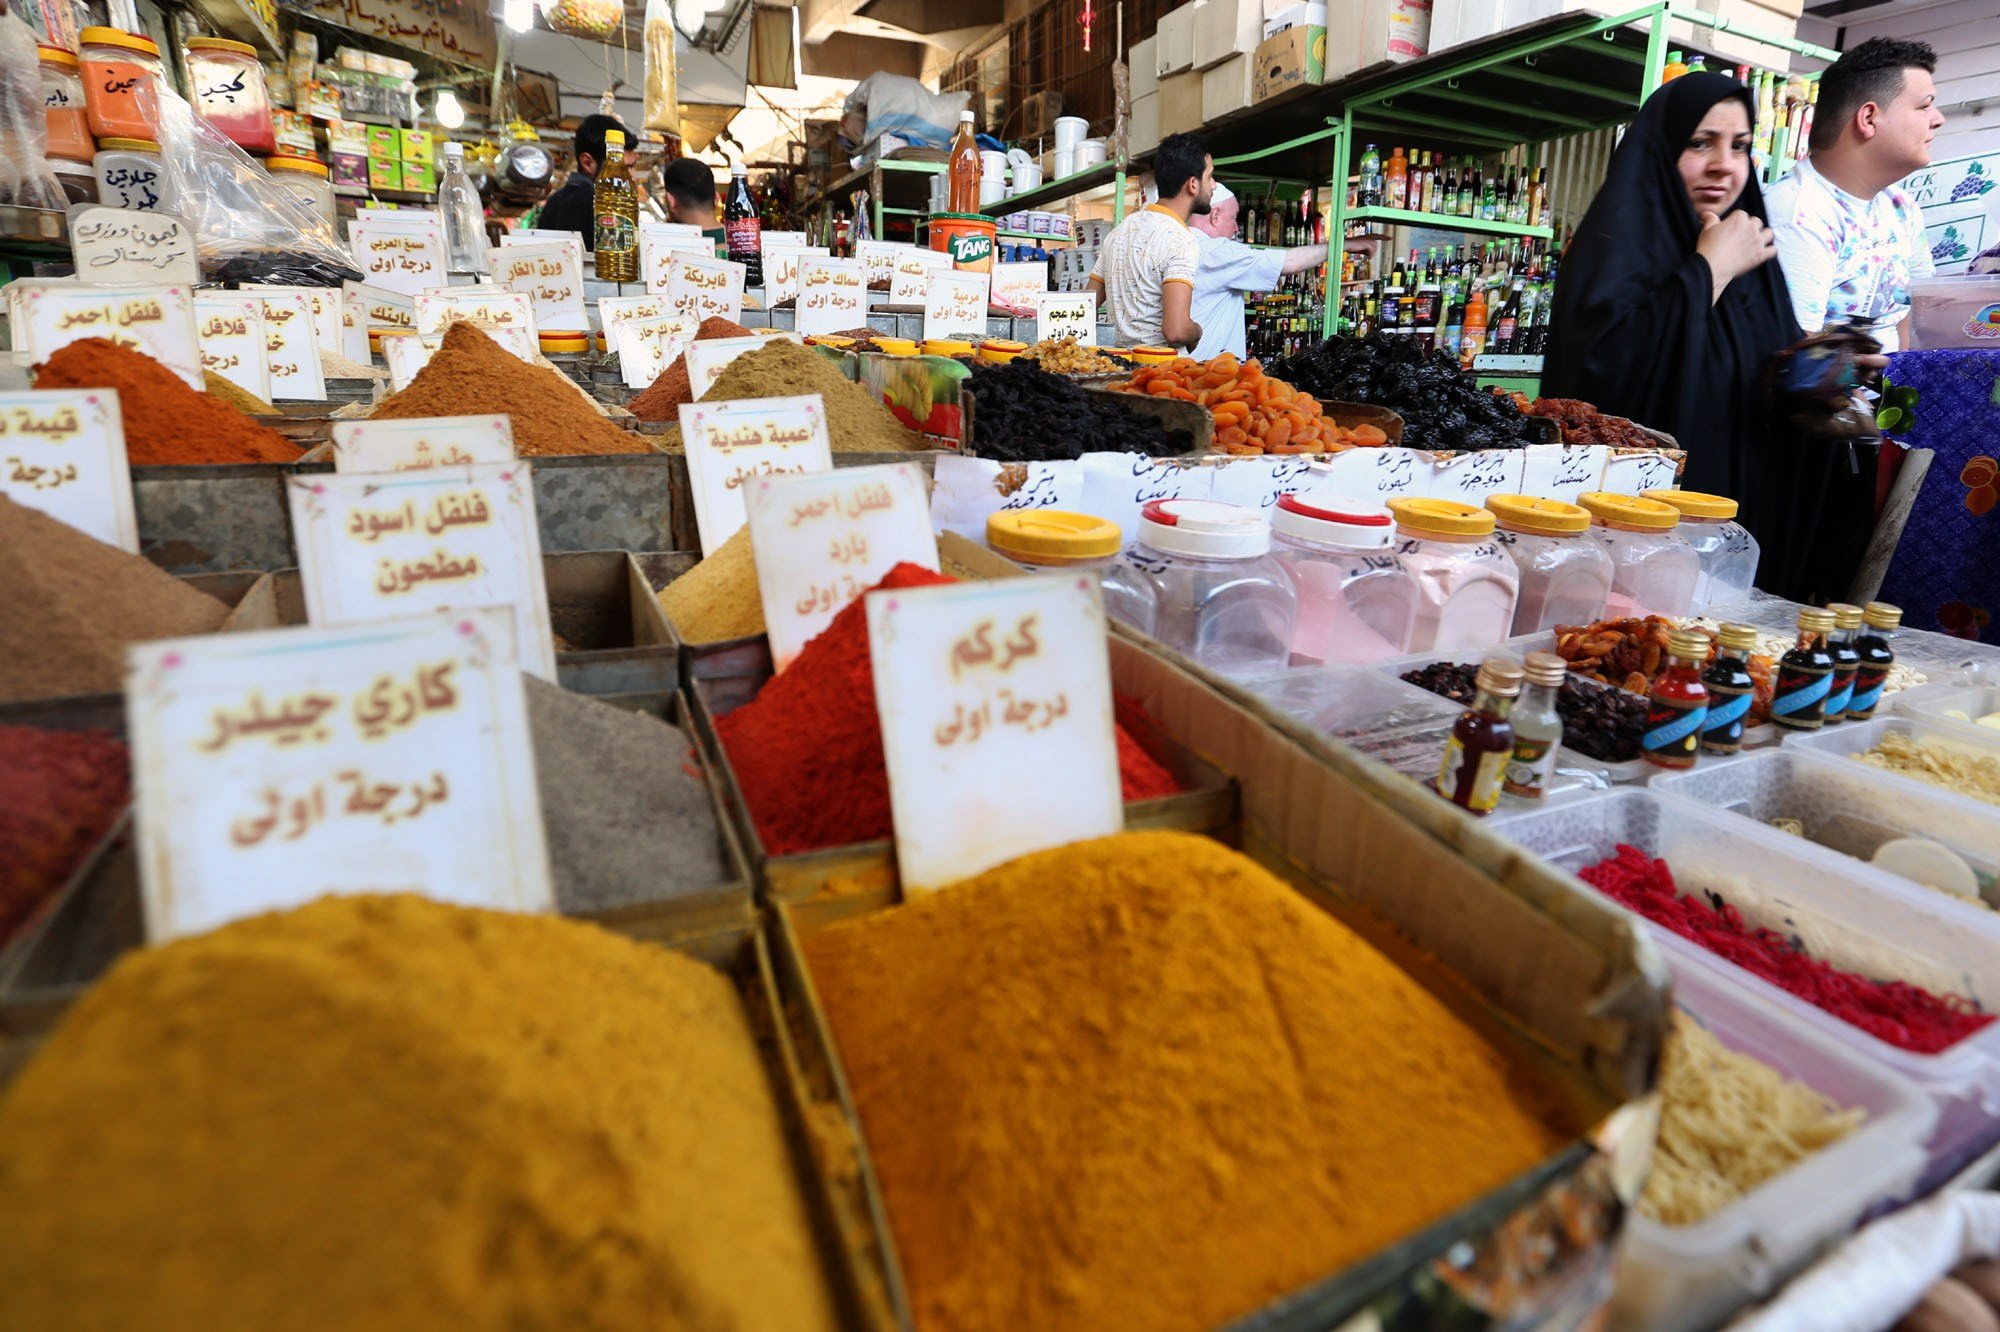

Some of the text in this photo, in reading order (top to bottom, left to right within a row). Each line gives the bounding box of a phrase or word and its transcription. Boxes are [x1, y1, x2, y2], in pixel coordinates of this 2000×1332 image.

[1899, 172, 1937, 190] ACK
[953, 238, 991, 261] TANG
[370, 255, 432, 274] درجة اولى
[507, 258, 563, 281] ورق الغار
[683, 264, 727, 290] فابريكة
[806, 268, 830, 287] خشن
[540, 284, 572, 303] درجة
[674, 293, 730, 314] درجة اولى
[807, 291, 857, 310] درجة اولى
[60, 301, 164, 330] فلفل احمر
[263, 303, 295, 326] حبة
[955, 305, 978, 321] درجة
[1070, 304, 1086, 321] ثوم
[202, 318, 247, 338] فلافل
[1066, 325, 1088, 340] درجة
[111, 333, 139, 348] حا
[200, 350, 239, 370] درجة
[268, 361, 299, 378] درج
[15, 409, 79, 440] قيمة
[707, 423, 810, 454] عمبة هندية
[6, 457, 78, 490] درجة
[789, 483, 893, 527] فلفل احمر
[350, 493, 490, 543] فلفل اسود
[829, 533, 868, 565] بارد
[376, 554, 478, 593] مطحون
[795, 581, 838, 616] اولى
[950, 615, 1041, 678] كركم
[355, 663, 456, 740] كاري
[934, 692, 1069, 746] درجة اولى
[230, 770, 448, 846] درجة اولى
